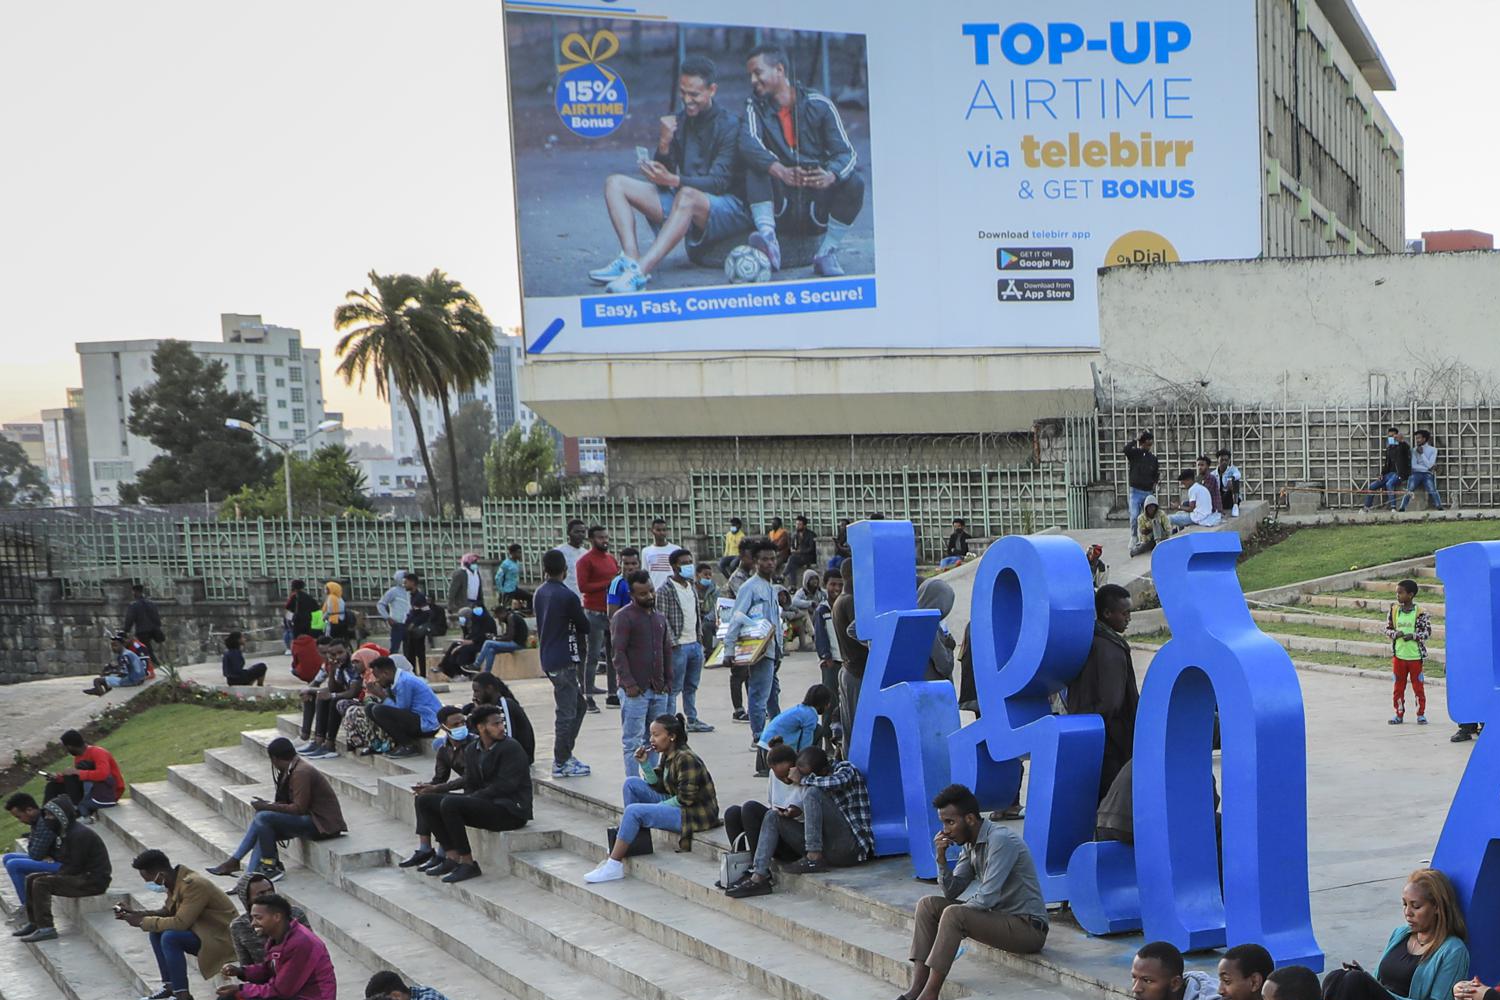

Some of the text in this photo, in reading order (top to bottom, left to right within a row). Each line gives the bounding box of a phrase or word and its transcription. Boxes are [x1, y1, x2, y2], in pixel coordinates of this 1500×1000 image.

[962, 20, 1192, 66] TOP-UP
[565, 80, 618, 102] 15%
[965, 78, 1193, 120] AIRTIME
[561, 103, 624, 115] AIRTIME
[571, 116, 615, 128] Bonus
[967, 132, 1194, 169] via telebirr
[1018, 179, 1195, 200] & GET BONUS
[978, 230, 1091, 241] Download telebirr app
[1019, 258, 1071, 268] Google Play
[1133, 249, 1166, 264] Dial
[595, 286, 864, 319] Easy, Fast, Convenient & Secure!
[1024, 289, 1071, 299] App Store
